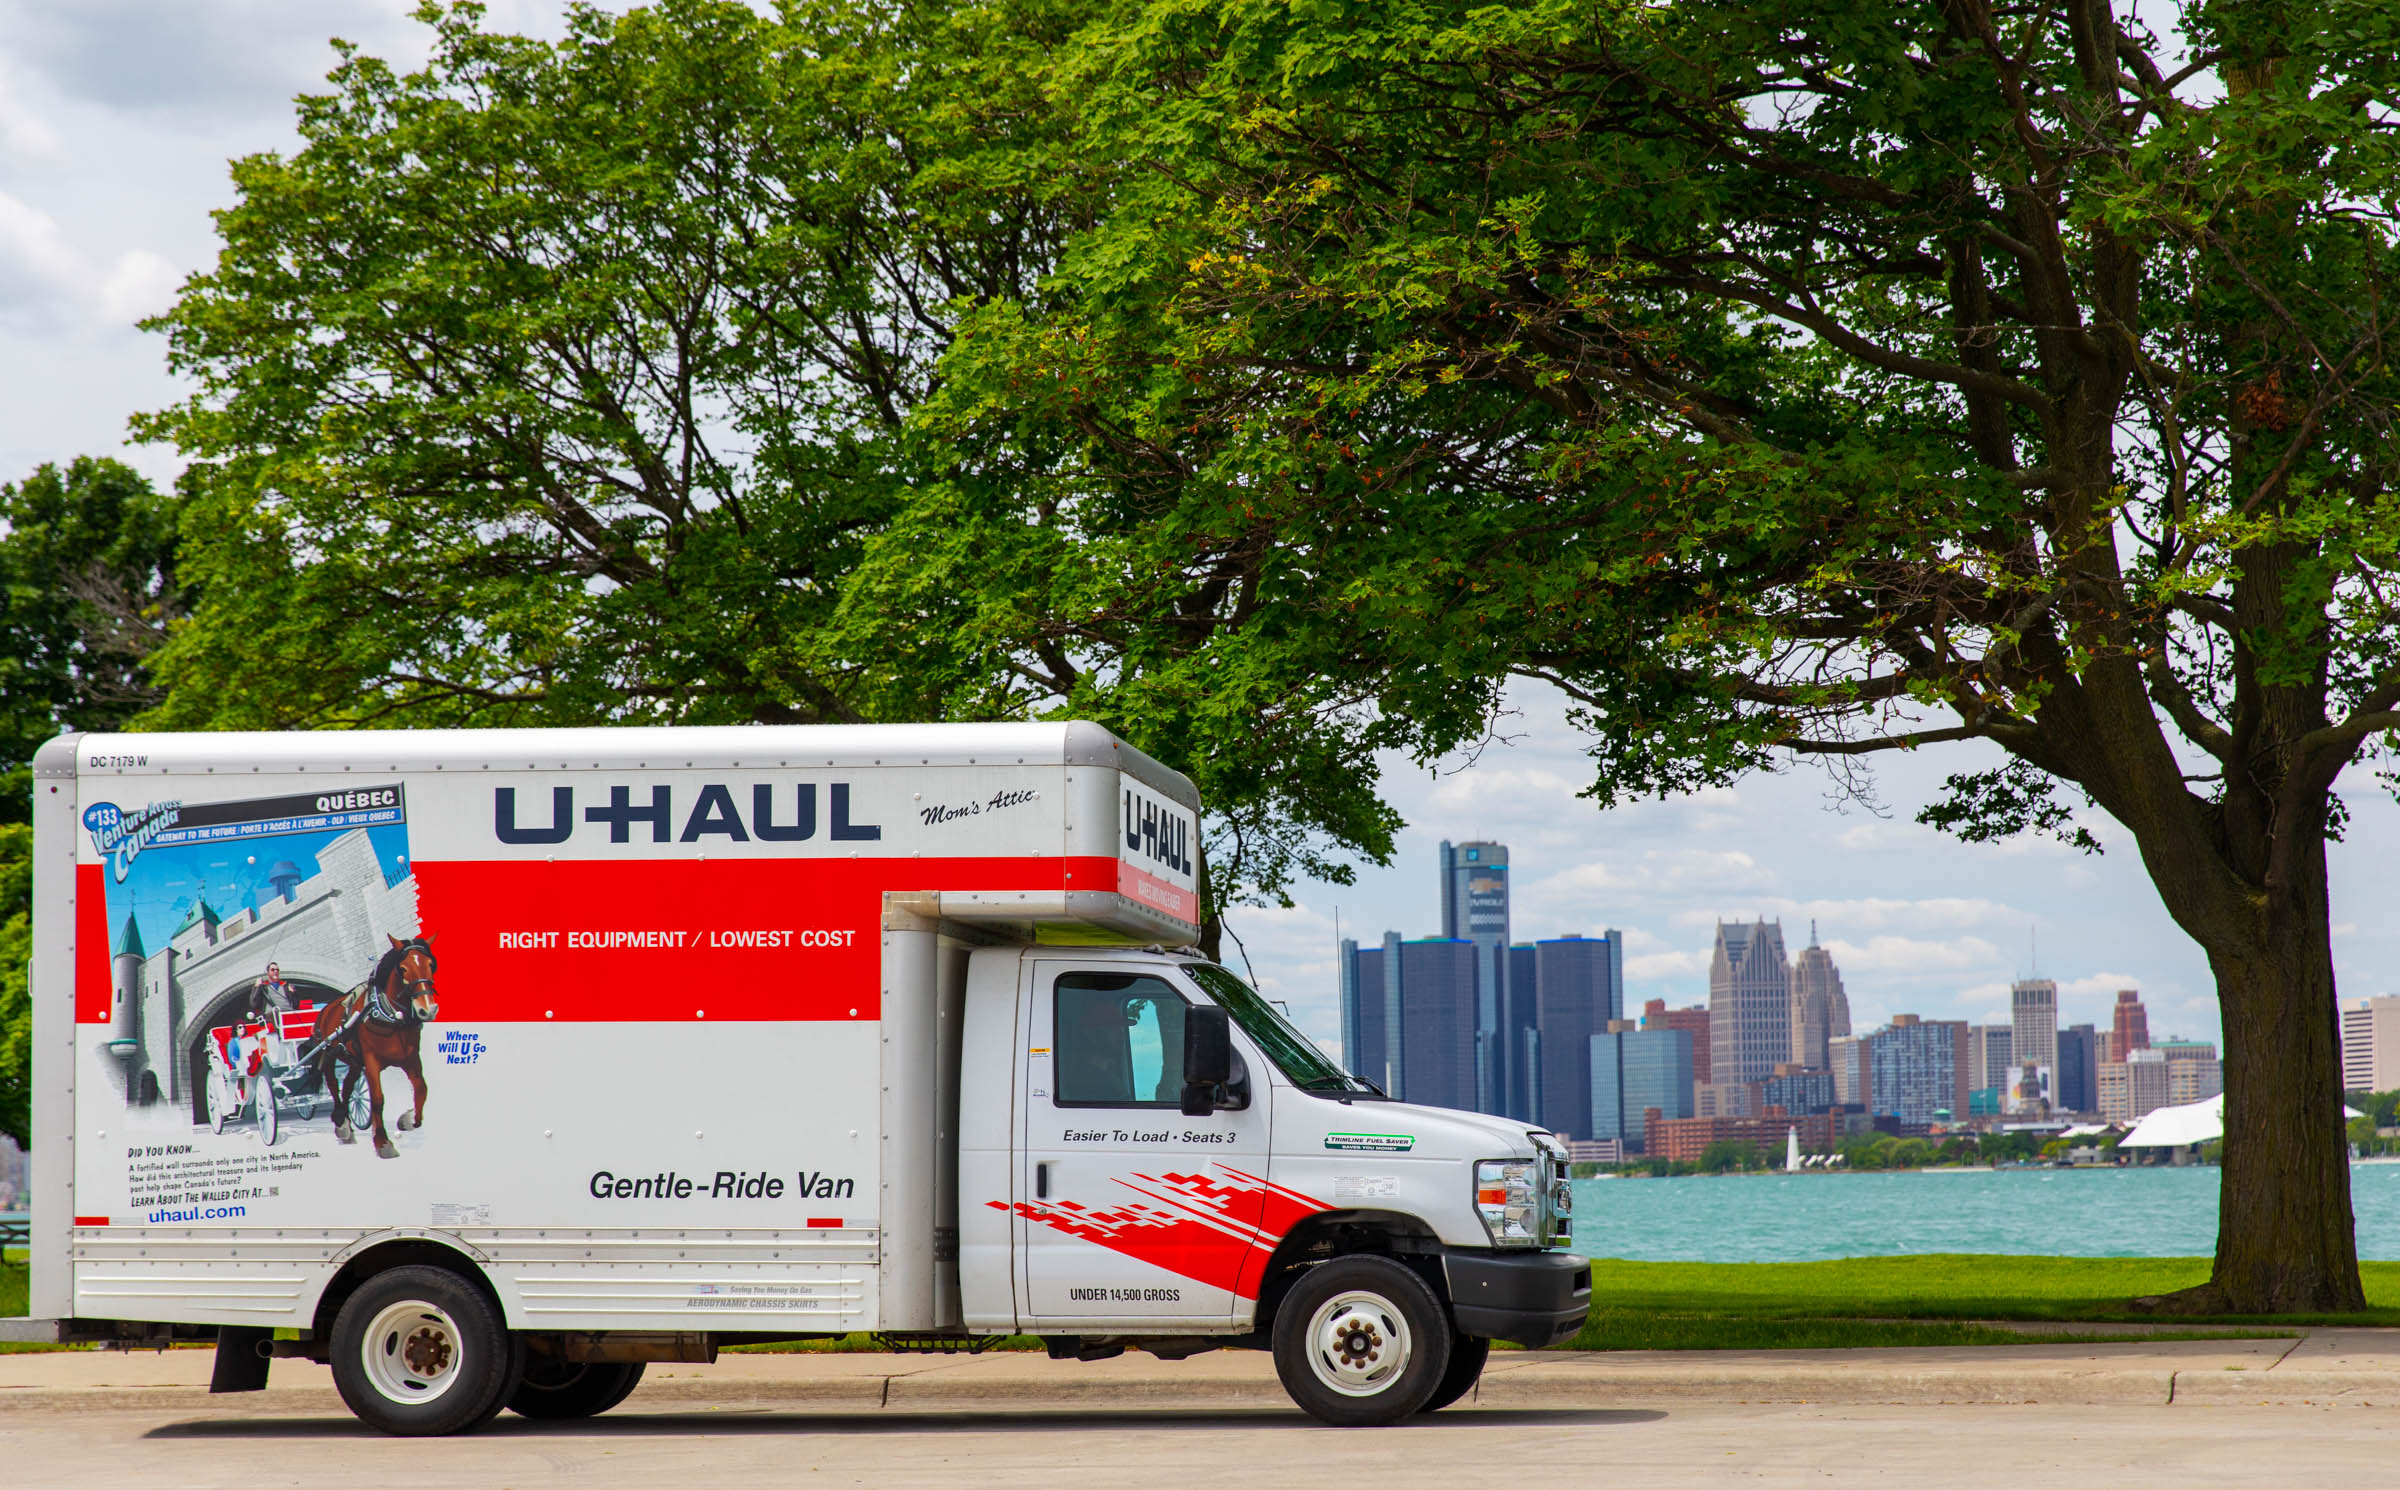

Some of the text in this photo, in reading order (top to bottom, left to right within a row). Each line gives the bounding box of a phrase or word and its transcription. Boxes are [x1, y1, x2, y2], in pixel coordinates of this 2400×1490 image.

[90, 755, 149, 768] DC 7179 W
[316, 790, 395, 812] QUÉBEC
[920, 789, 1034, 826] Mom's Attic
[87, 808, 118, 826] #133
[495, 783, 881, 845] U-HAUL
[91, 811, 148, 856] Venture
[188, 829, 198, 840] TO
[198, 828, 211, 839] THE
[211, 825, 238, 838] FUTURE
[240, 822, 262, 835] PORTE
[331, 815, 345, 826] OLD
[1126, 789, 1191, 877] U-HAUL
[115, 809, 179, 884] Canada
[499, 932, 559, 949] RIGHT
[567, 931, 688, 950] EQUIPMENT
[709, 930, 794, 949] LOWEST
[799, 930, 856, 948] COST
[446, 1031, 479, 1041] Where
[438, 1042, 487, 1056] Will U Go
[1063, 1129, 1237, 1144] Easier To Load Seats 3
[127, 1147, 143, 1159] DID
[145, 1145, 164, 1157] YOU
[128, 1164, 135, 1173] A
[136, 1162, 164, 1172] fortified
[166, 1160, 180, 1170] wall
[182, 1158, 214, 1169] surrounds
[216, 1157, 230, 1167] only
[232, 1157, 244, 1165] one
[246, 1155, 259, 1164] city
[260, 1154, 268, 1162] in
[269, 1153, 289, 1162] North
[129, 1161, 304, 1183] How did this architectural treasure and its legendary
[130, 1175, 242, 1195] past help shape Canada's future?
[590, 1170, 855, 1199] Gentle-Ride Van
[131, 1196, 156, 1208] LEARN
[157, 1194, 183, 1205] ABOUT
[185, 1192, 200, 1203] THE
[201, 1190, 231, 1203] WALLED
[232, 1188, 250, 1200] CITY
[149, 1206, 247, 1223] uhaul.com
[730, 1286, 812, 1296] Saving You Money On Gas
[1070, 1288, 1181, 1302] UNDER 14,500 GROSS
[687, 1299, 819, 1309] AERODYNAMIC CHASSIS SKIRTS
